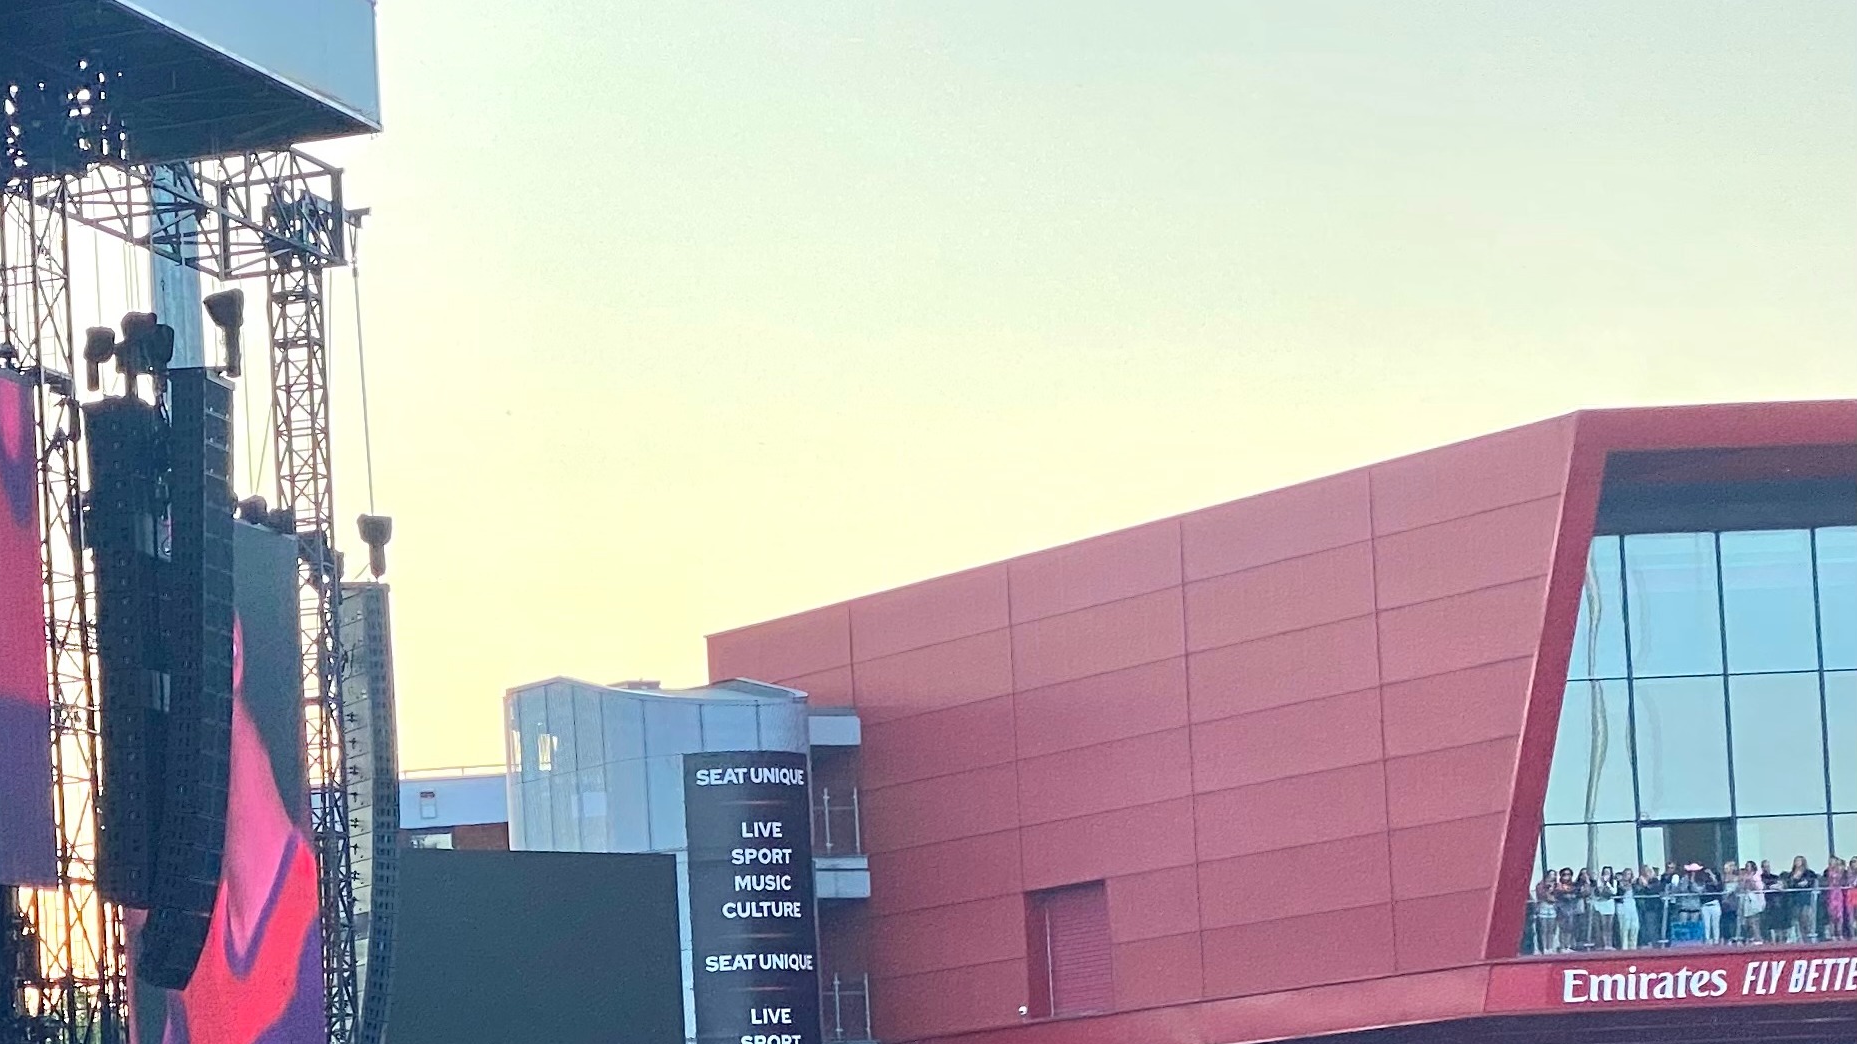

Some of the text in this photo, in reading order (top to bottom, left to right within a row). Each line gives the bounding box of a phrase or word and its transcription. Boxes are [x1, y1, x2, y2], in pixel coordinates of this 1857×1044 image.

[696, 767, 804, 786] SEAT UNIQUE
[741, 821, 783, 838] LIVE
[731, 848, 792, 865] SPORT
[734, 874, 792, 892] MUSIC
[722, 902, 802, 919] CULTURE
[705, 953, 813, 972] SEAT UNIQUE
[1563, 965, 1728, 1003] Emirates
[1742, 960, 1786, 995] FLY
[750, 1008, 792, 1025] LIVE
